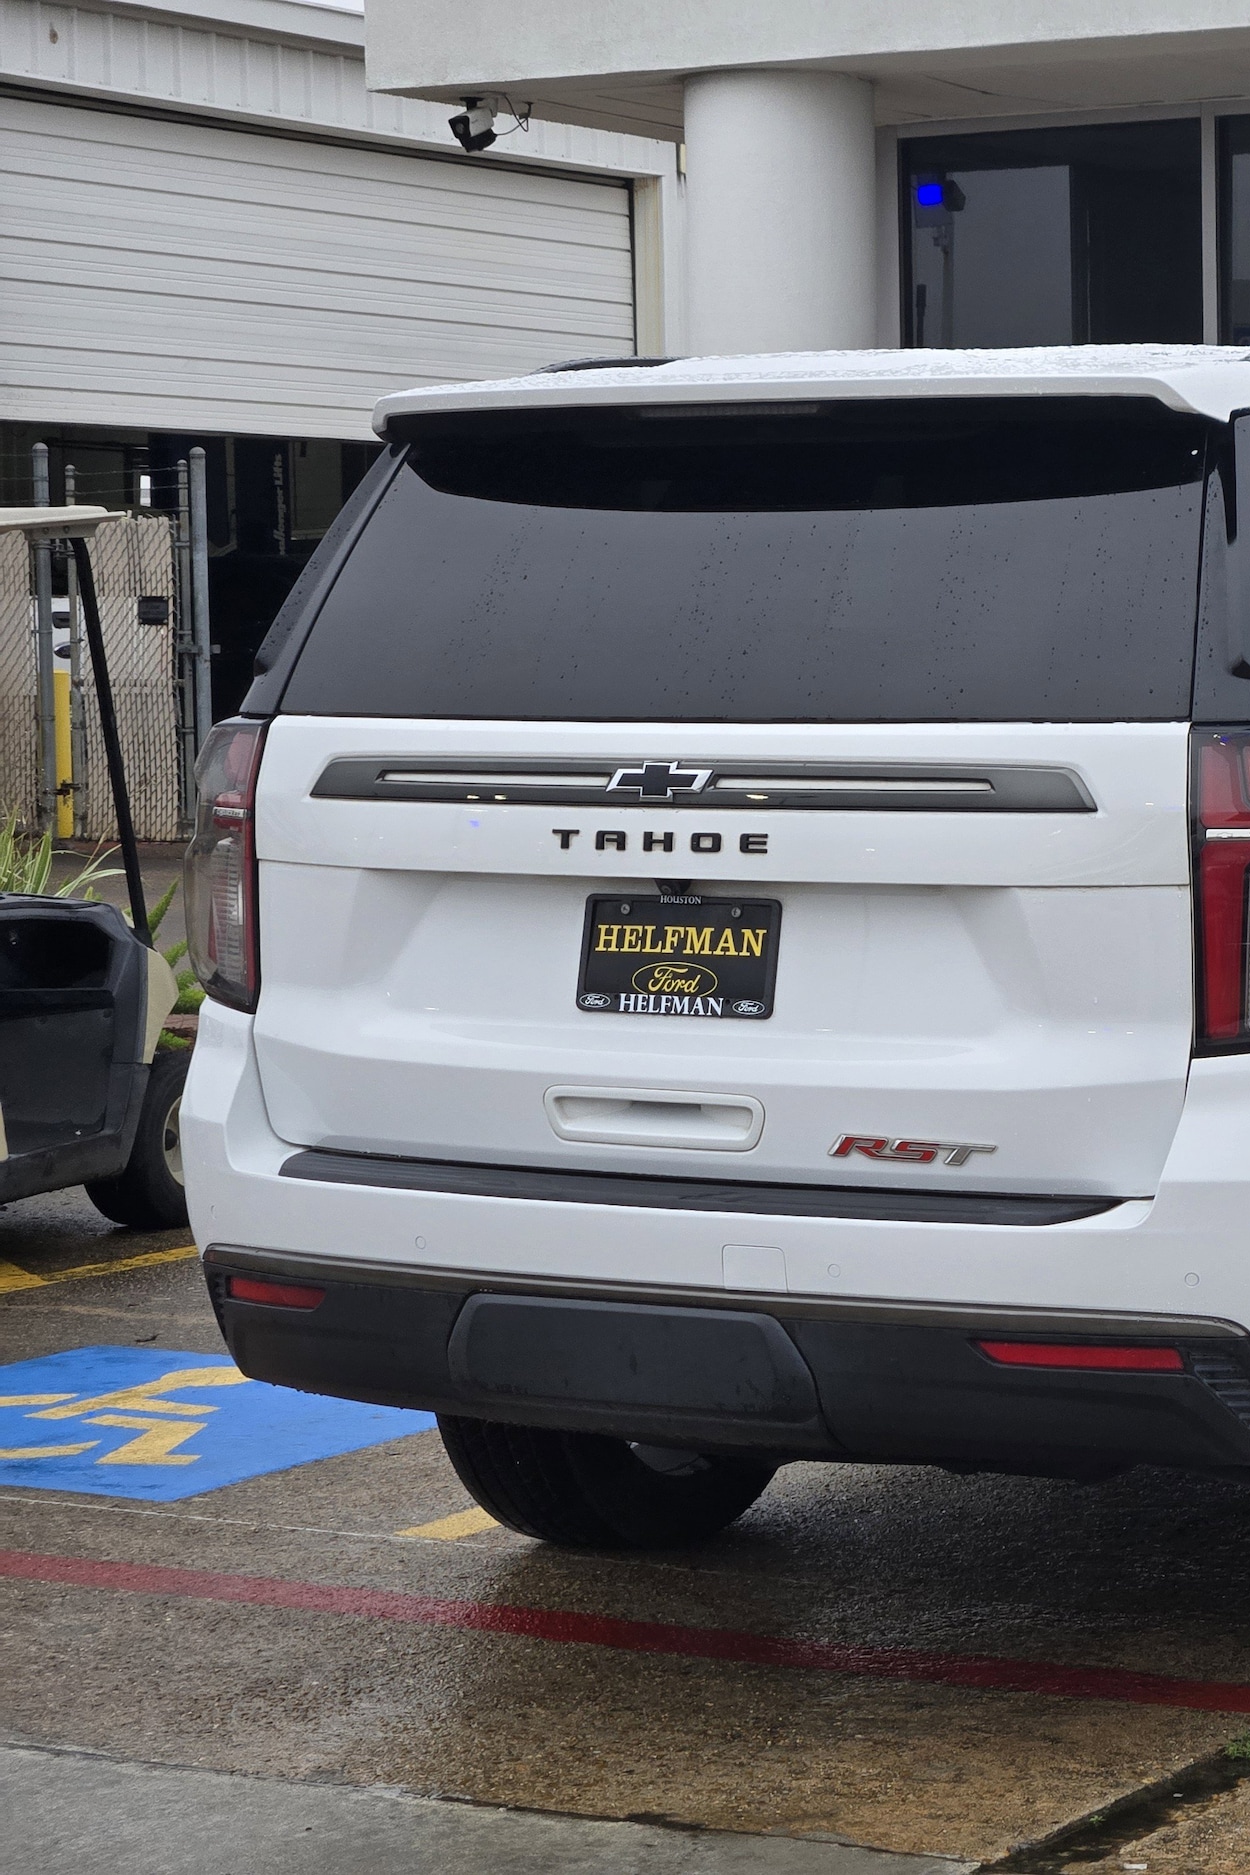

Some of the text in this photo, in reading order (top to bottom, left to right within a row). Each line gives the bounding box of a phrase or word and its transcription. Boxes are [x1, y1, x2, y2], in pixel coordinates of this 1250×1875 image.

[552, 829, 769, 854] TAHOE
[660, 894, 702, 905] HOUSTON
[595, 924, 767, 957] HELFMAN
[647, 966, 701, 993] Ford
[618, 993, 724, 1016] HELFMAN
[828, 1133, 998, 1166] RST
